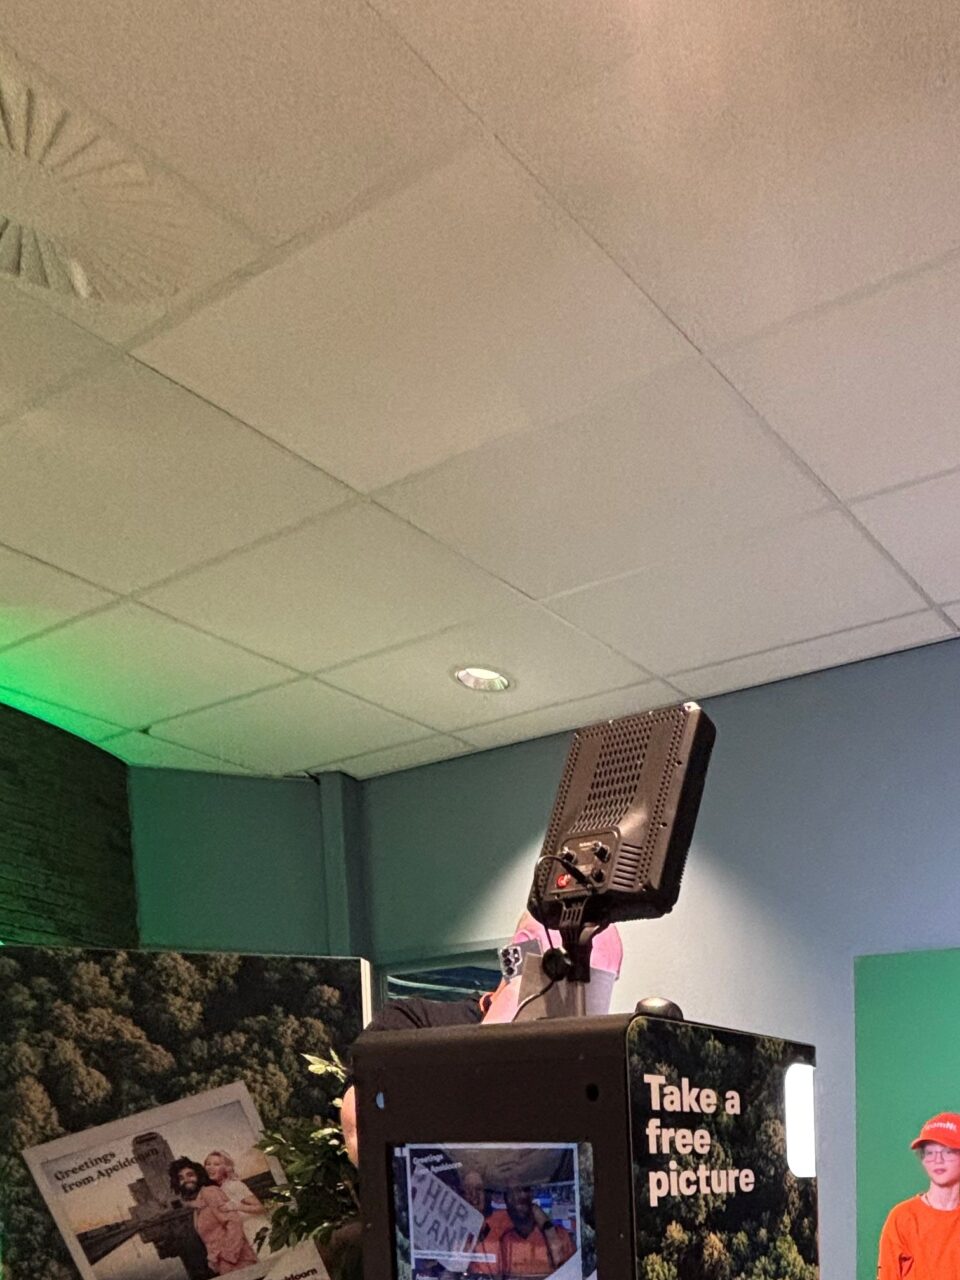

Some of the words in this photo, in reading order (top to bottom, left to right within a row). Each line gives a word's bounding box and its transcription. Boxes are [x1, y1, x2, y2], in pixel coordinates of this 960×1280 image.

[643, 1073, 717, 1114] Take
[725, 1089, 741, 1115] a
[645, 1118, 711, 1154] free
[53, 1150, 117, 1181] Greetings
[61, 1174, 95, 1194] from
[96, 1146, 160, 1179] Apeldoorn
[648, 1160, 755, 1207] picture
